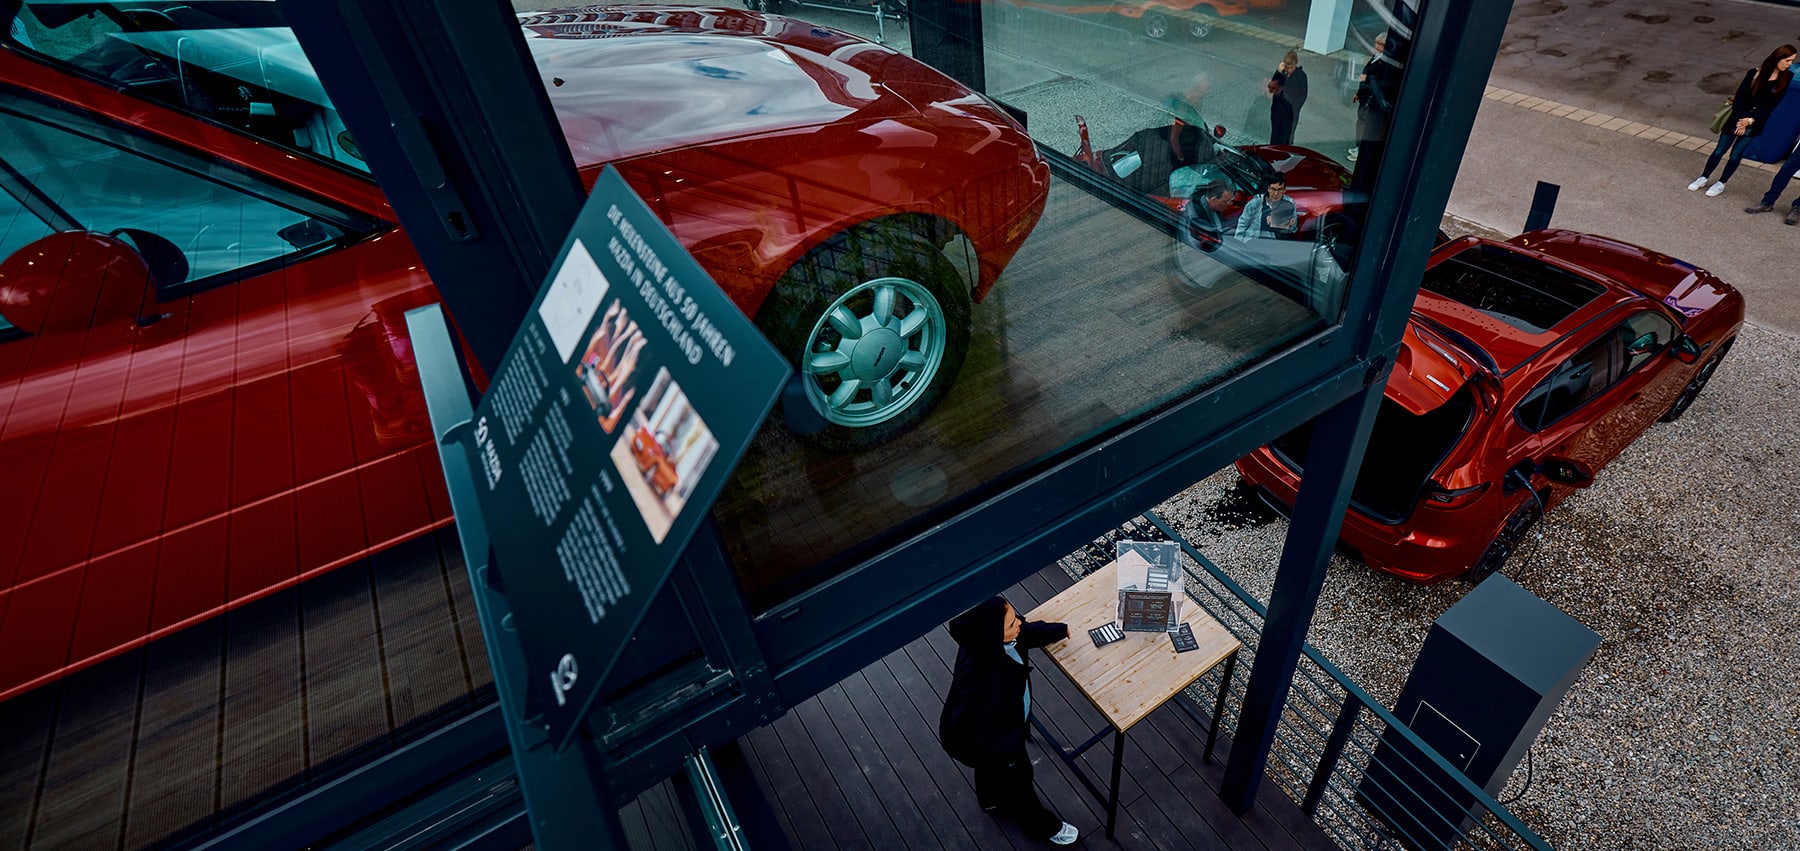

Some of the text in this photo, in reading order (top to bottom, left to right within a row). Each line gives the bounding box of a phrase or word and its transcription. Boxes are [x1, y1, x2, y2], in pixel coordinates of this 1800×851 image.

[607, 204, 736, 367] DIE MEILENSTEINE AUS 50 JAHREN
[607, 236, 703, 365] MAZDA IN DEUTSCHLAND
[485, 439, 502, 483] MAZDA
